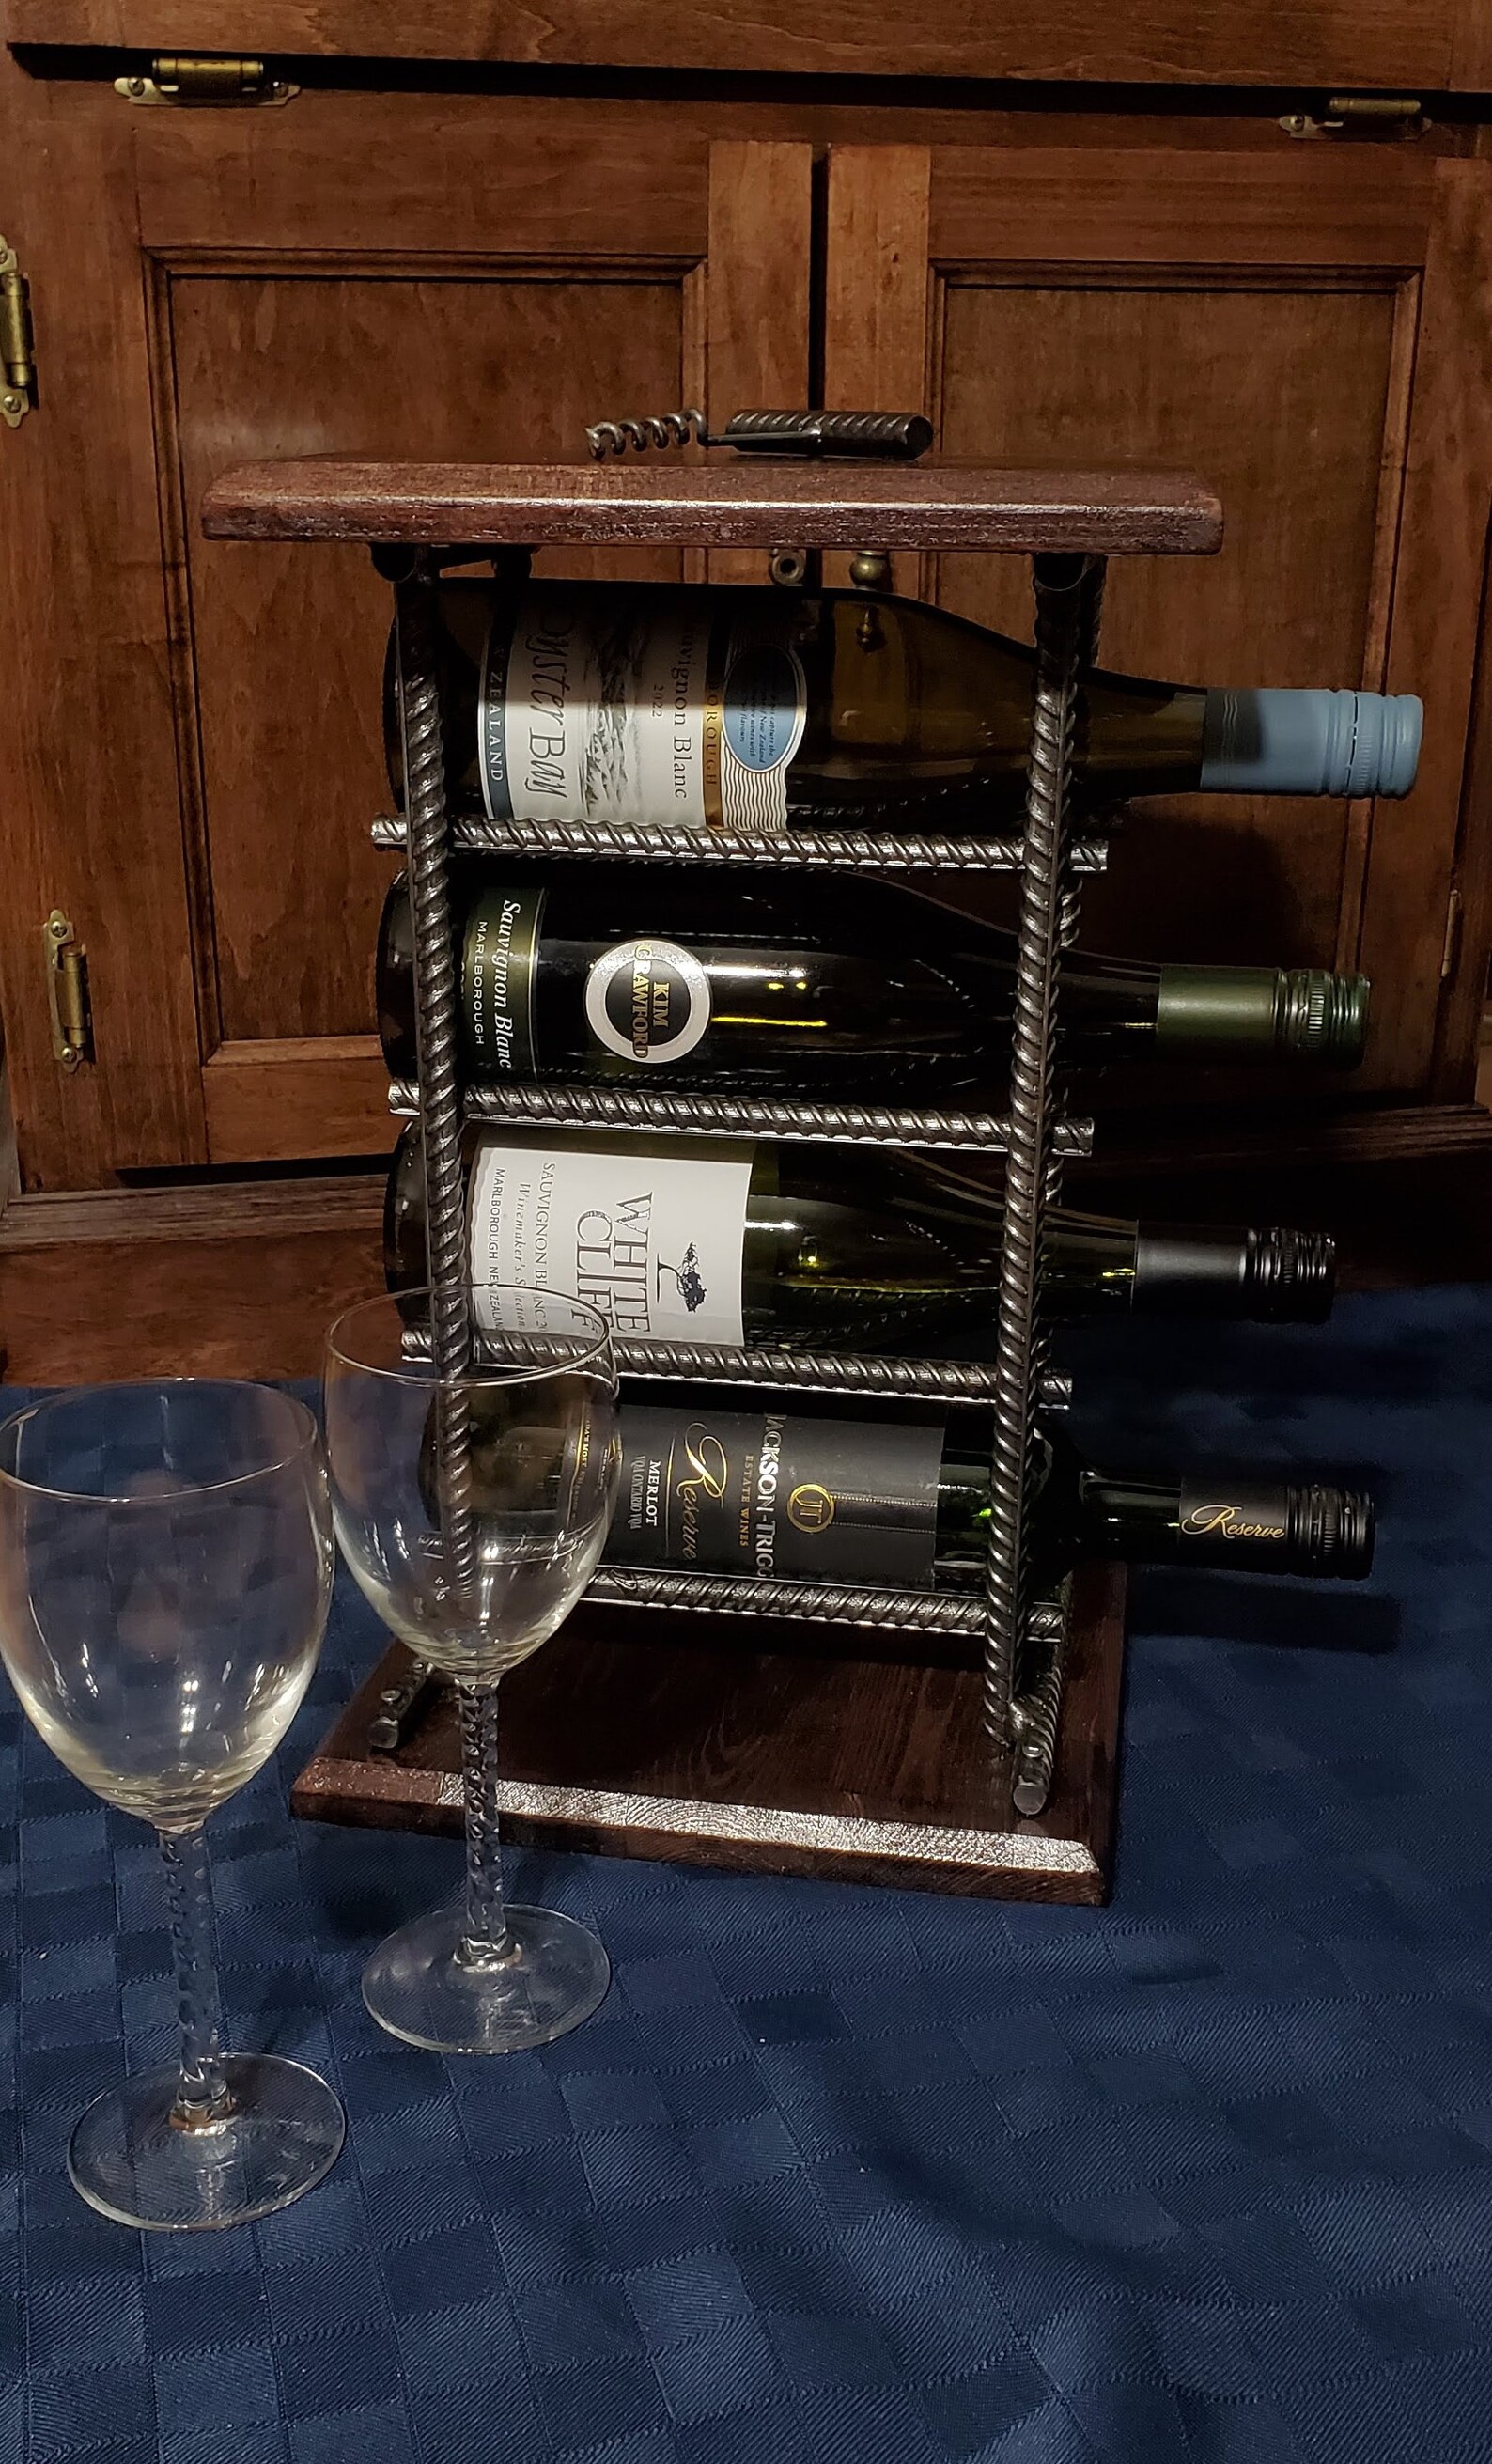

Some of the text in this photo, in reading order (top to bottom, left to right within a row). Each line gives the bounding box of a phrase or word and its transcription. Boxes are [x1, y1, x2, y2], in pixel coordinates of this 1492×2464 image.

[487, 670, 505, 782] ZEALAND
[651, 684, 664, 718] 2022
[671, 620, 701, 799] uvignon Blanc
[706, 681, 718, 785] OROUGH
[524, 727, 568, 798] Bay
[472, 921, 488, 1045] MARLBOROUGH
[491, 899, 521, 1068] Sauvignon Blanc
[632, 943, 653, 1059] CRAWFORD
[653, 982, 670, 1028] KIM
[487, 1168, 506, 1260] MARLBOROUGH
[513, 1182, 532, 1327] Winemaker's Slection
[534, 1162, 556, 1265] SAUVIGNON
[614, 1191, 654, 1333] WHITE
[489, 1294, 504, 1331] ZEALAN
[571, 1209, 614, 1333] CLIFF
[627, 1455, 646, 1530] VQA ONTARIO VQA
[645, 1459, 661, 1527] MERLOT
[676, 1422, 728, 1560] Reserve
[739, 1455, 754, 1548] ESTATE WINES
[1181, 1505, 1286, 1539] Reserve
